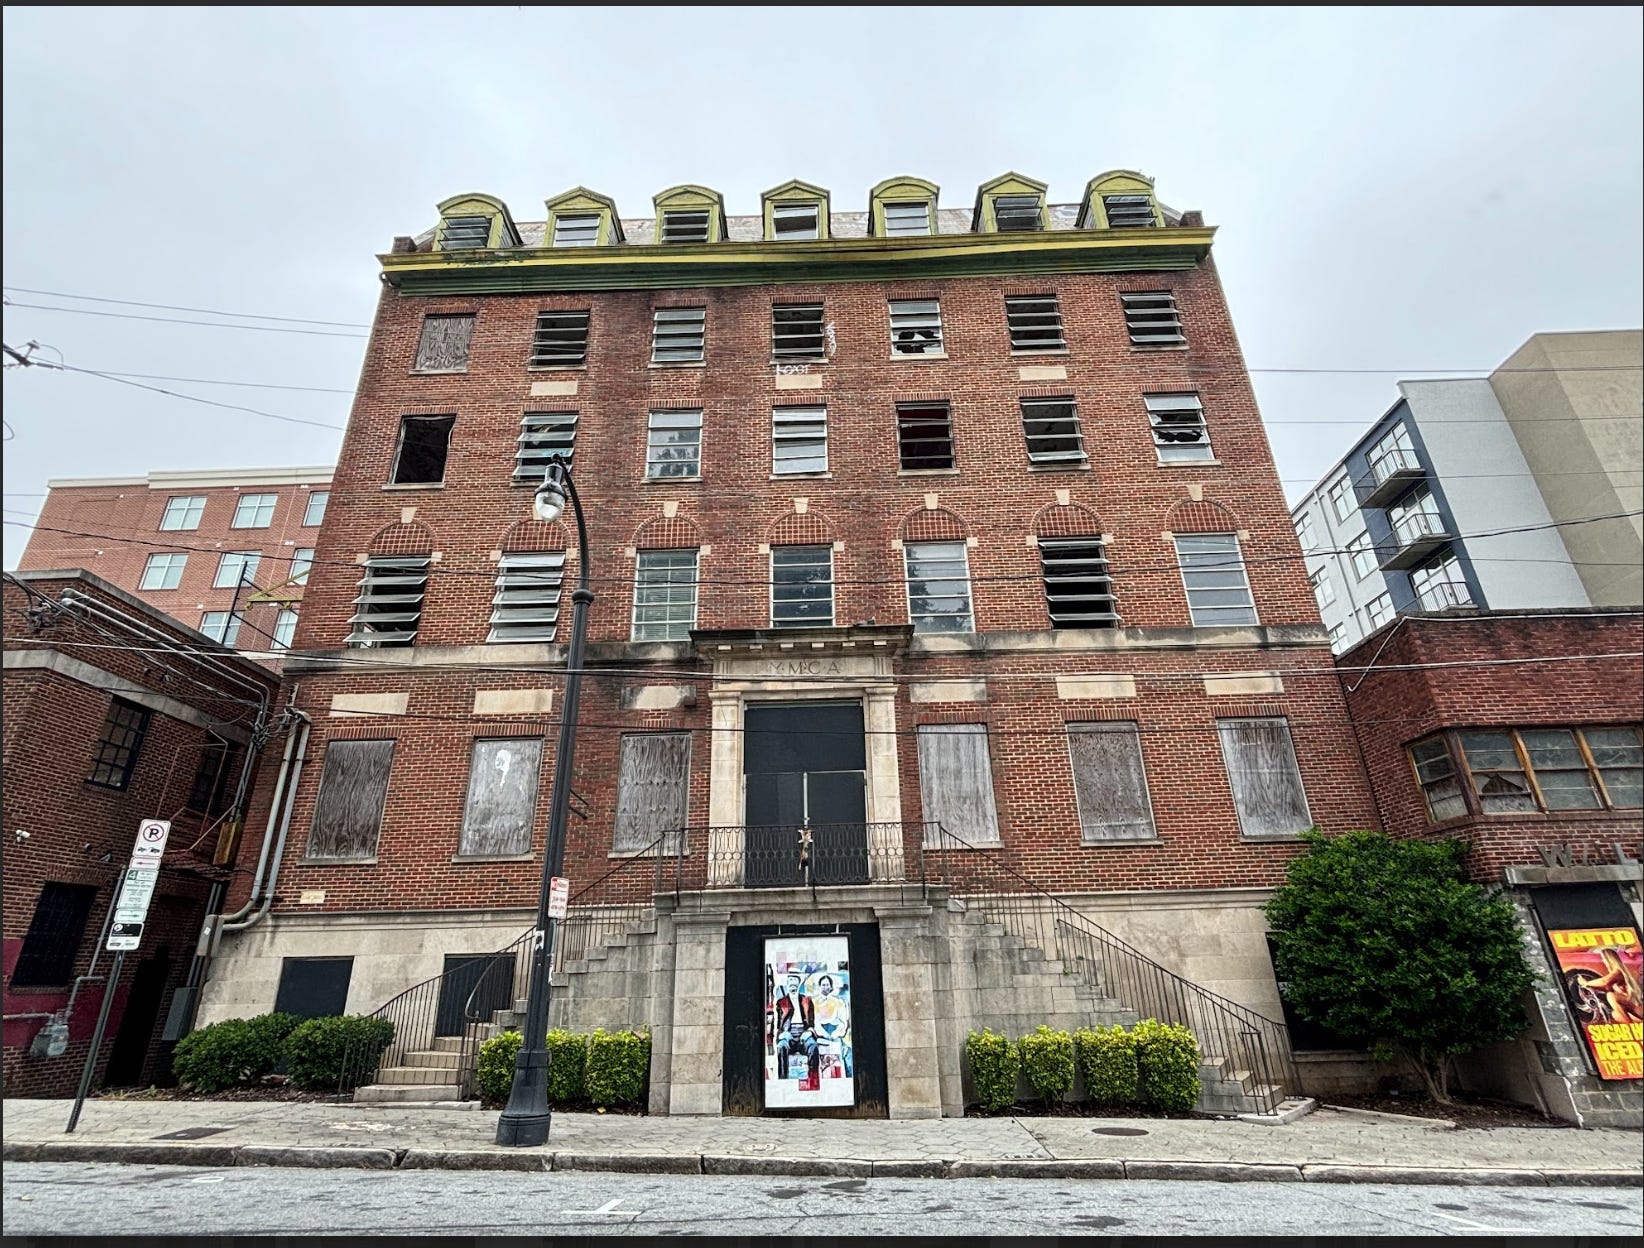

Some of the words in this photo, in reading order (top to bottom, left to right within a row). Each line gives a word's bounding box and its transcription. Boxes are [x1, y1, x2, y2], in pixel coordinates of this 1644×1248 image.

[1553, 931, 1636, 948] LATTO
[1587, 1023, 1636, 1041] SUGAR
[1593, 1041, 1643, 1060] ICED
[1601, 1060, 1626, 1076] THE
